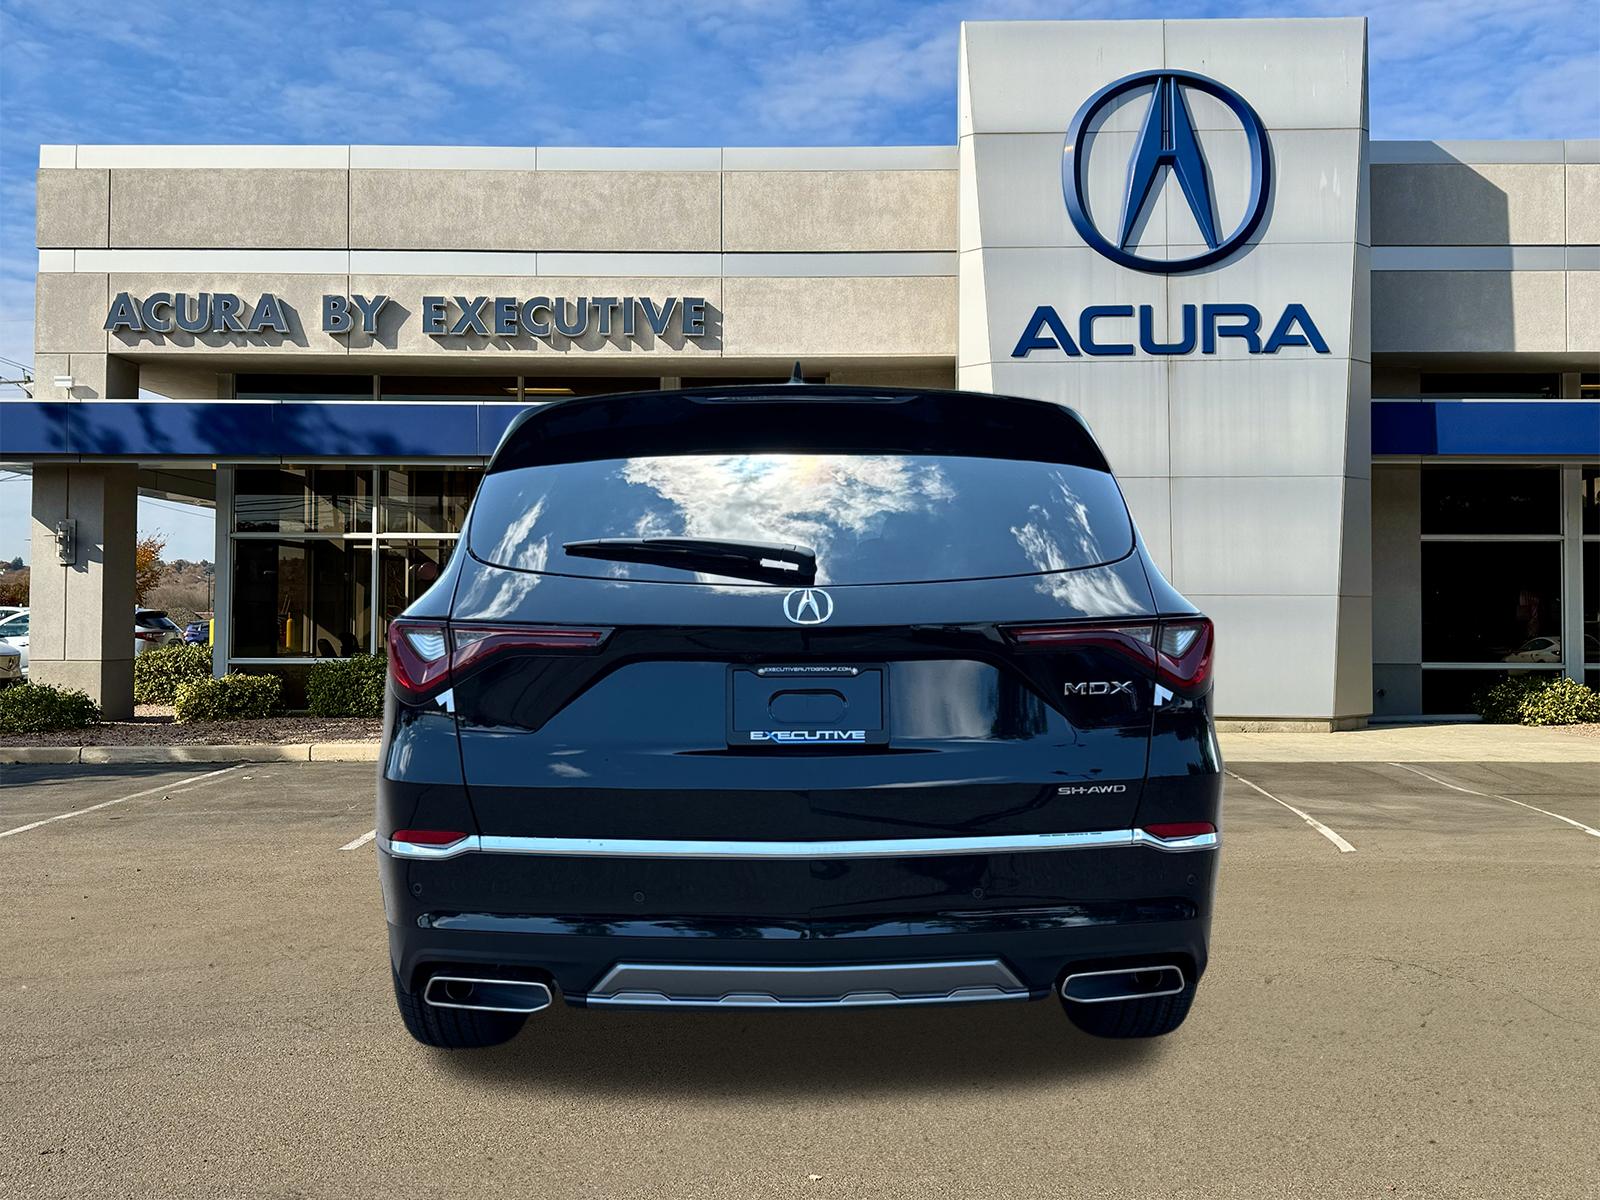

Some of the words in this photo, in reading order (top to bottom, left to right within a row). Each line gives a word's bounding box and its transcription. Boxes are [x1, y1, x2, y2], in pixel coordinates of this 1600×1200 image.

[104, 291, 289, 334] ACURA
[322, 294, 389, 333] BY
[422, 295, 708, 337] EXECUTIVE
[1010, 303, 1332, 358] ACURA
[1063, 680, 1133, 696] MDX
[750, 730, 866, 743] EXECUTIVE
[1057, 784, 1127, 795] SH-AWD
